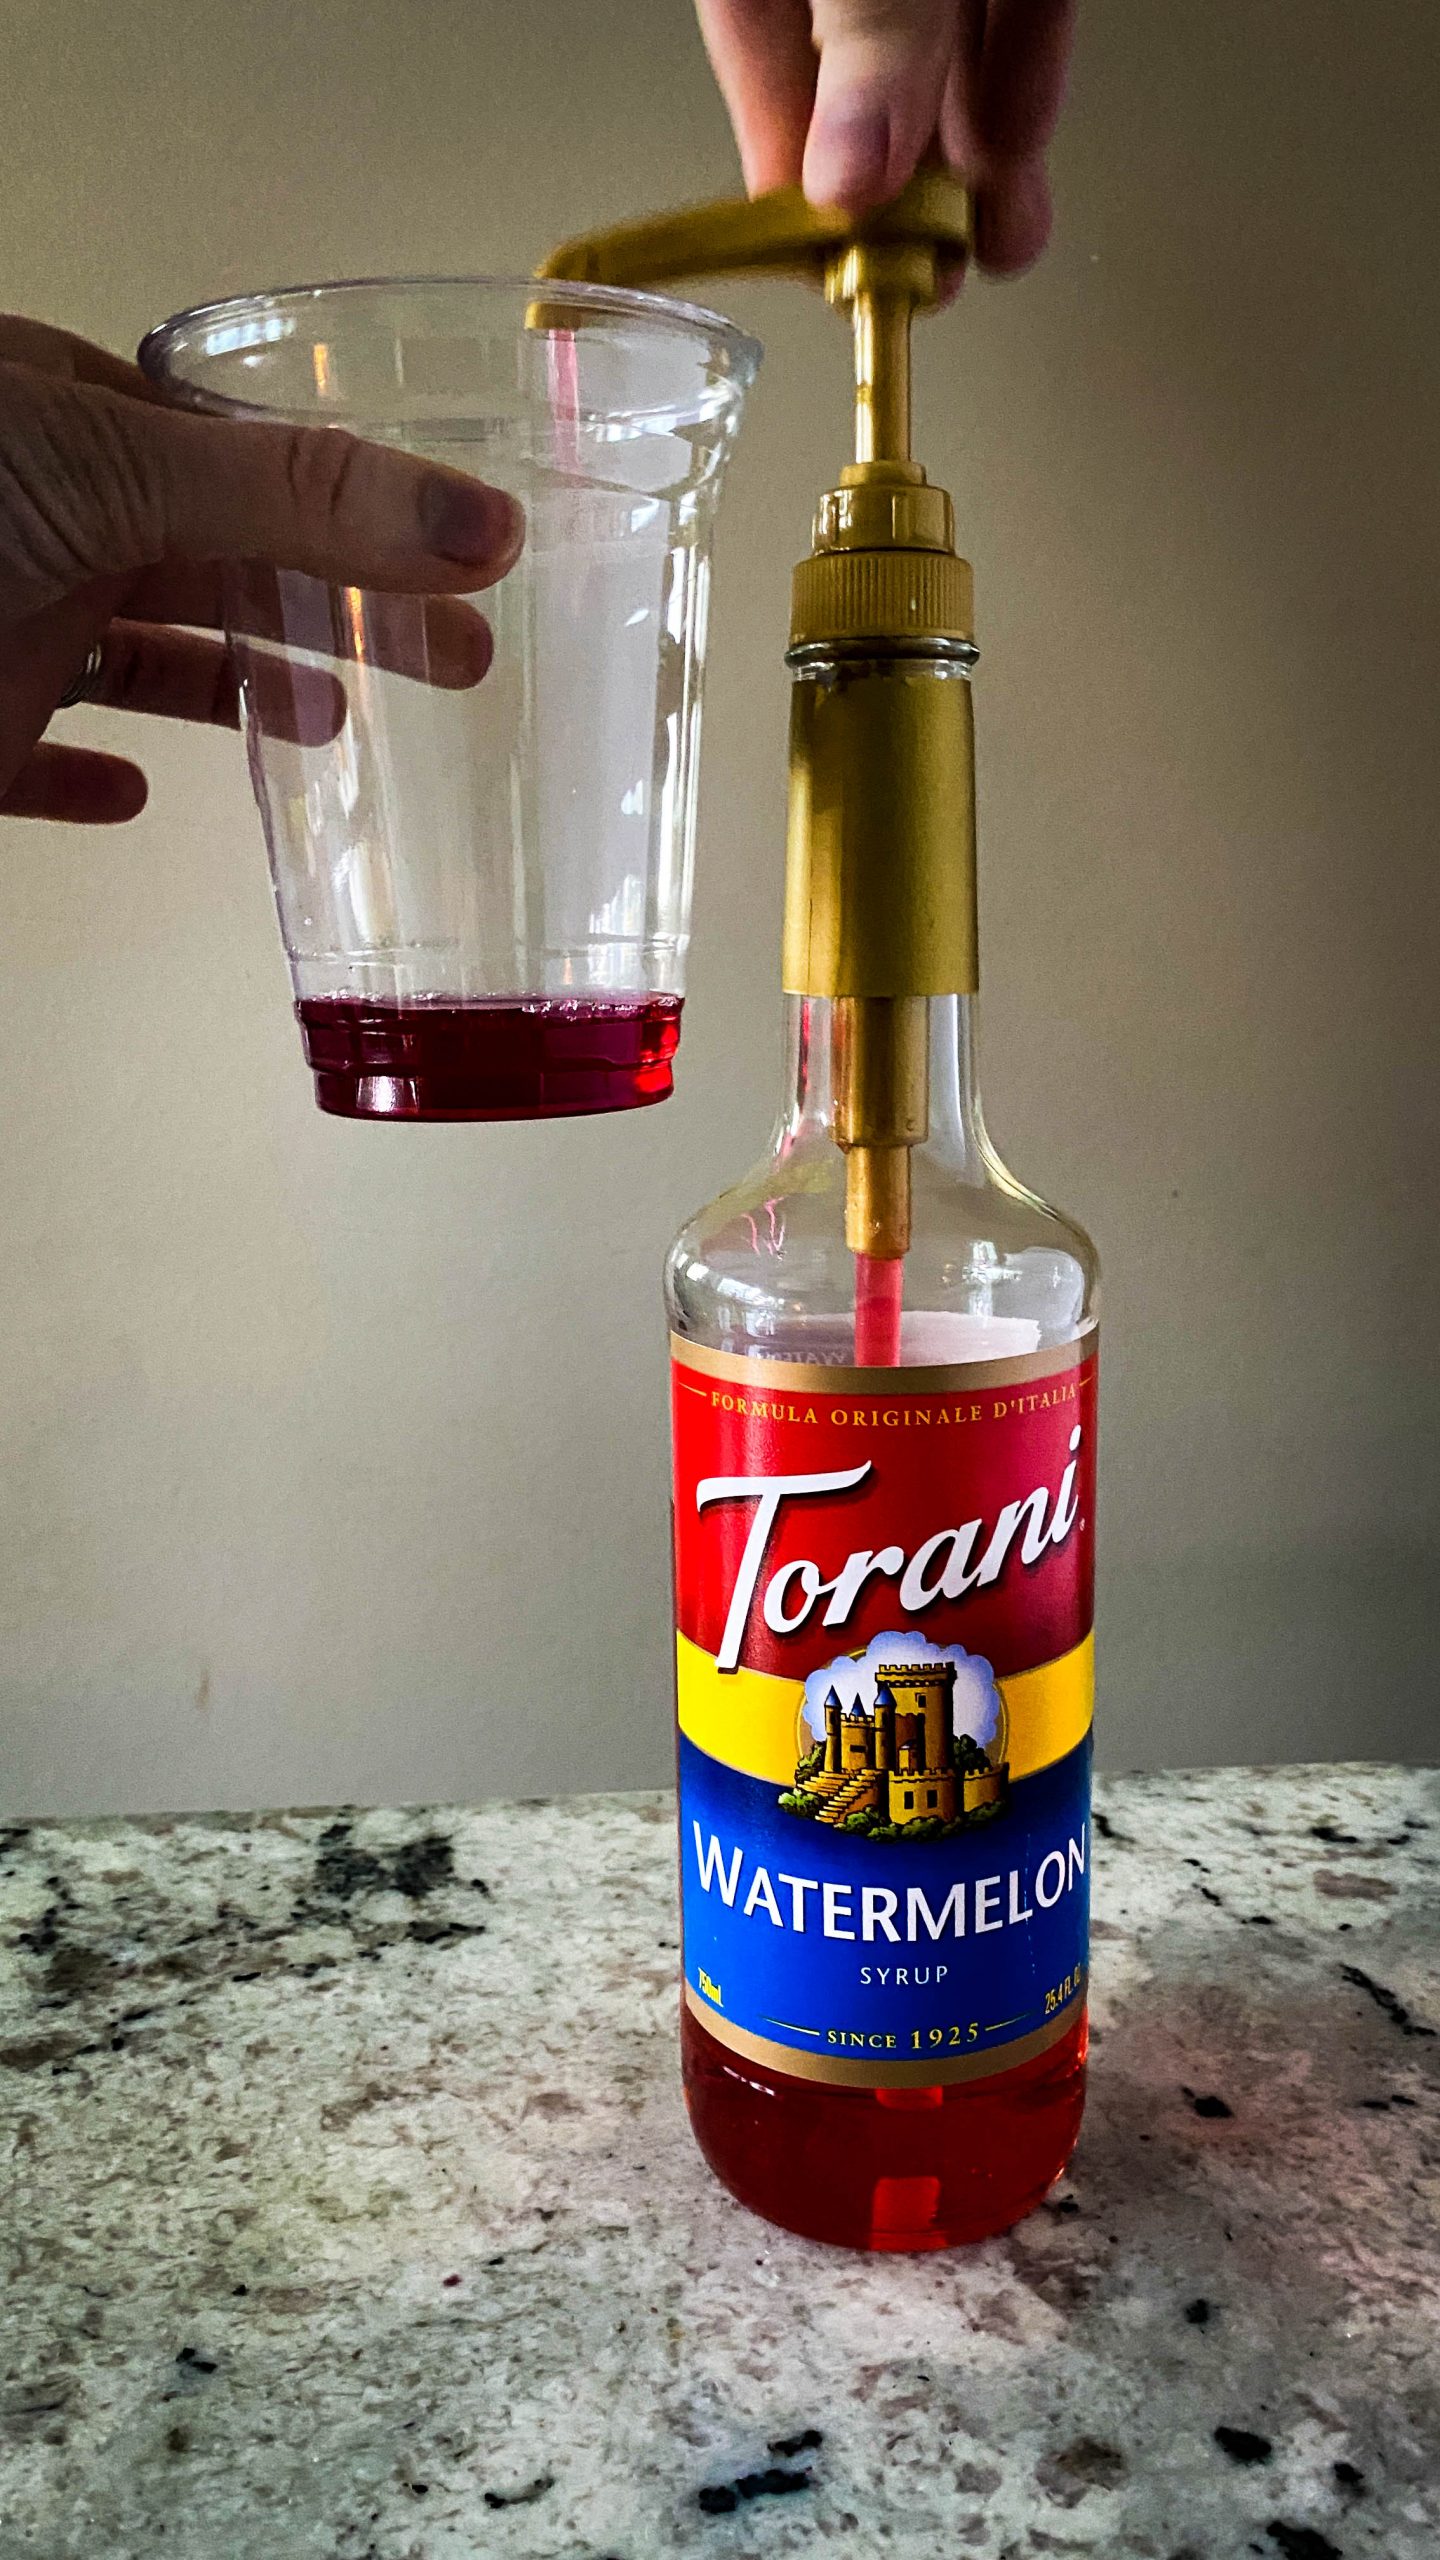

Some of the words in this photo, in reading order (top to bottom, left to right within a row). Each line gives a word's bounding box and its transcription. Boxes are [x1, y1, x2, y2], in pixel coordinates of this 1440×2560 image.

[711, 1392, 818, 1425] FORMULA
[831, 1405, 982, 1427] ORIGINALE
[993, 1386, 1077, 1419] D'ITALIA
[696, 1424, 1081, 1669] Torani
[693, 1820, 1086, 1942] WATERMELON
[860, 1965, 948, 1985] SYRUP
[1045, 1983, 1063, 2014] 25.4
[827, 2030, 897, 2049] SINCE
[911, 2022, 979, 2050] 1925
